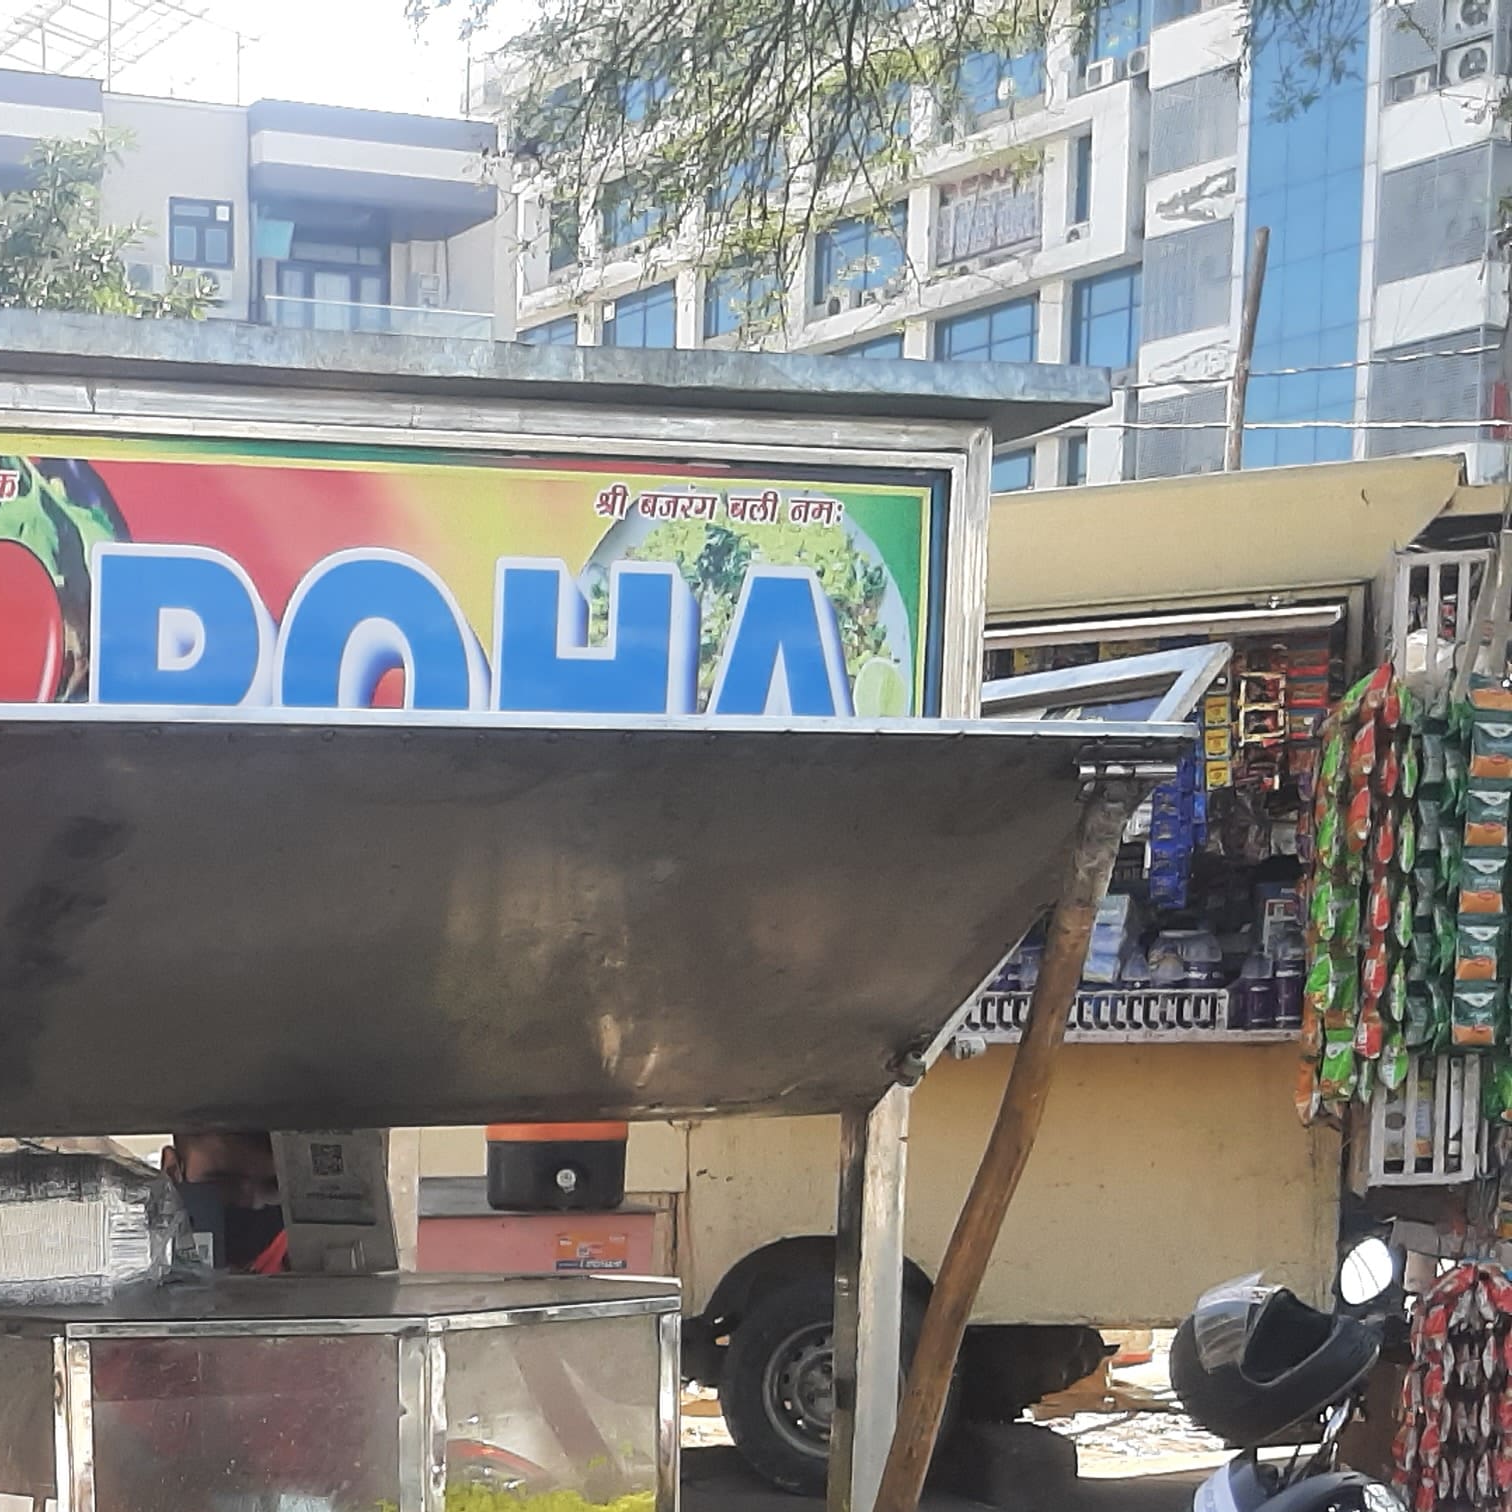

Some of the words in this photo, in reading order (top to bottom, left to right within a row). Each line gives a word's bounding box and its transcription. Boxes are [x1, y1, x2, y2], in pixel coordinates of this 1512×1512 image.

[596, 484, 630, 519] श्री
[728, 490, 781, 524] बली
[91, 542, 852, 717] POHA
